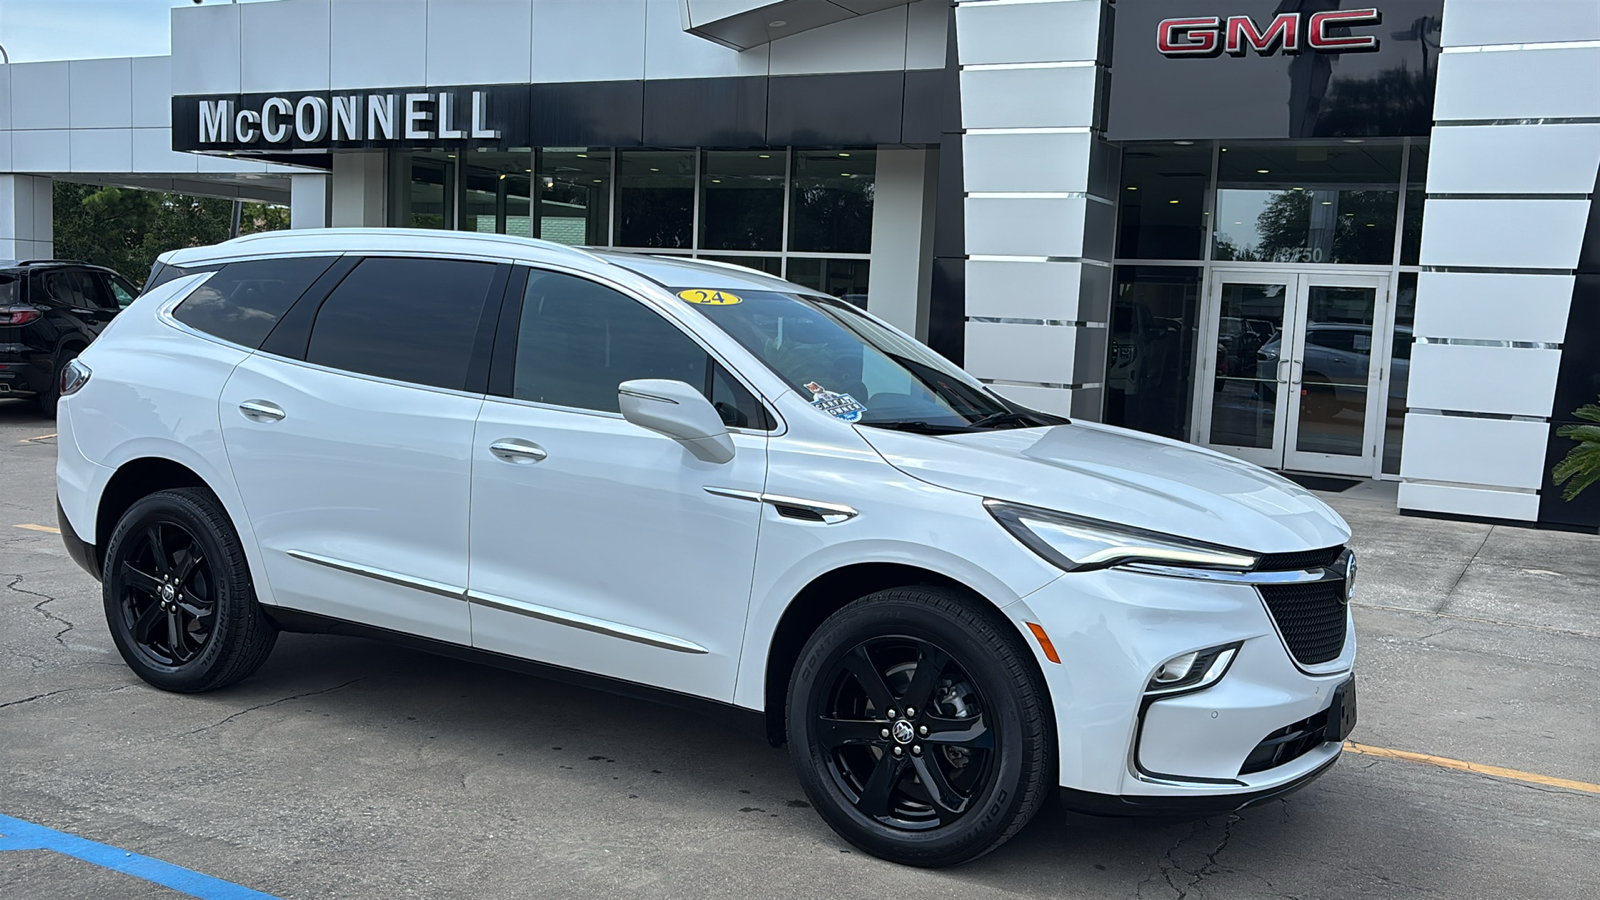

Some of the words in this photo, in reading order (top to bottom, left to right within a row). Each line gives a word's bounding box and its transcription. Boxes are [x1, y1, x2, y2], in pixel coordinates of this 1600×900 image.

[1157, 8, 1381, 56] GMC
[198, 91, 500, 144] McCONNELL
[695, 290, 725, 304] 24
